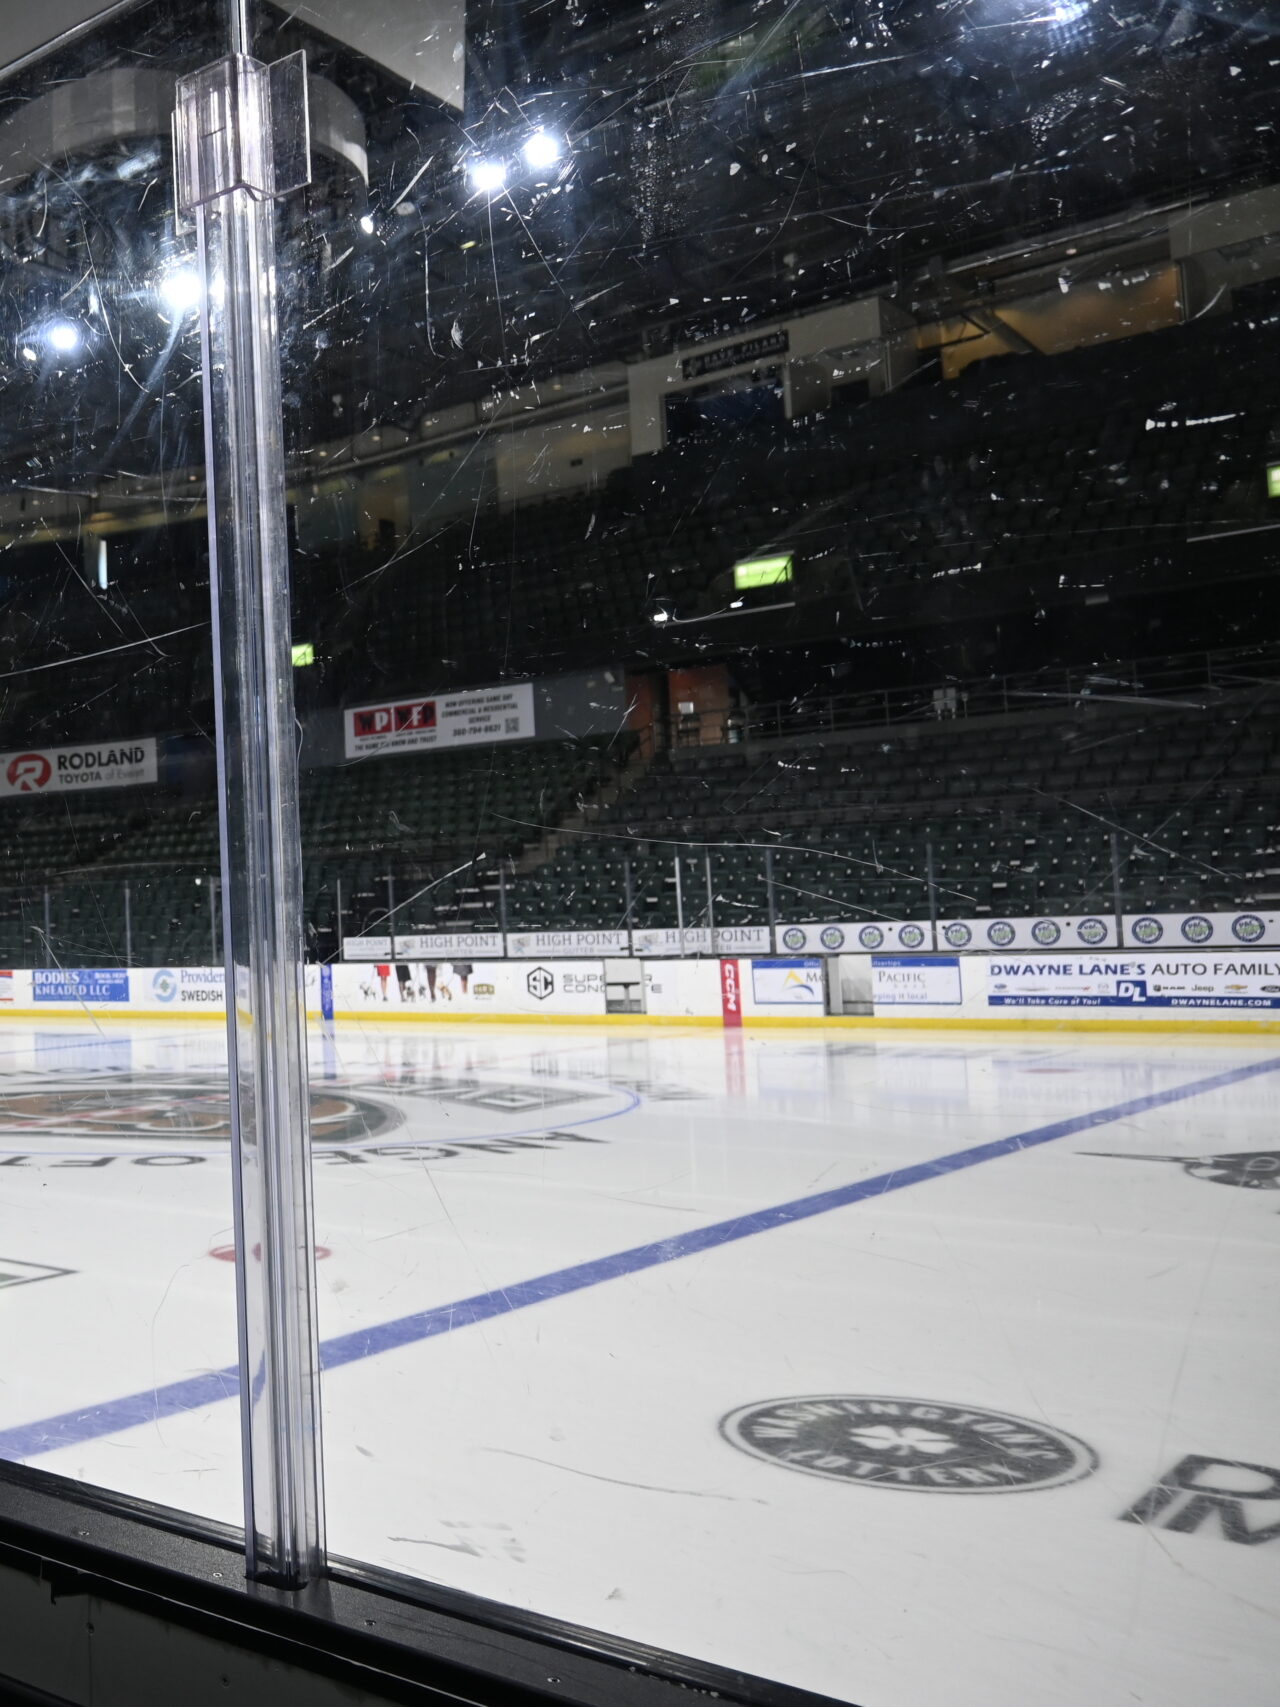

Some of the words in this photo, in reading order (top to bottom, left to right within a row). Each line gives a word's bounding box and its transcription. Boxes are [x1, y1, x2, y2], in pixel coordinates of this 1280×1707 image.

[442, 708, 476, 718] COMMERCIAL
[391, 739, 406, 747] KNOW
[407, 737, 418, 745] AND
[420, 735, 437, 744] TRUST
[57, 747, 145, 770] RODLAND
[58, 771, 103, 784] TOYOTA
[420, 936, 453, 949] HIGH
[457, 934, 499, 948] POINT
[536, 934, 572, 946] HIGH
[576, 931, 622, 945] POINT
[666, 931, 707, 943] HIGH
[711, 928, 764, 942] POINT
[990, 964, 1073, 976] DWAYNE
[1079, 963, 1146, 976] LANE'S
[1151, 963, 1208, 976] AUTO
[35, 971, 80, 984] BODIES
[878, 970, 926, 983] PACIFIC
[35, 984, 87, 996] KNEADED
[90, 984, 111, 995] LLC
[724, 963, 737, 1011] CCM
[1191, 984, 1214, 992] Jeep
[181, 990, 223, 1001] SWEDISH
[1004, 997, 1025, 1005] We'll
[1027, 997, 1046, 1005] Take
[1048, 997, 1068, 1005] Care
[1071, 997, 1080, 1005] of
[1170, 998, 1272, 1006] DWAYNELANE.COM
[753, 1401, 1061, 1461] WASHINGTON'S
[784, 1448, 1026, 1485] LOTTERY
